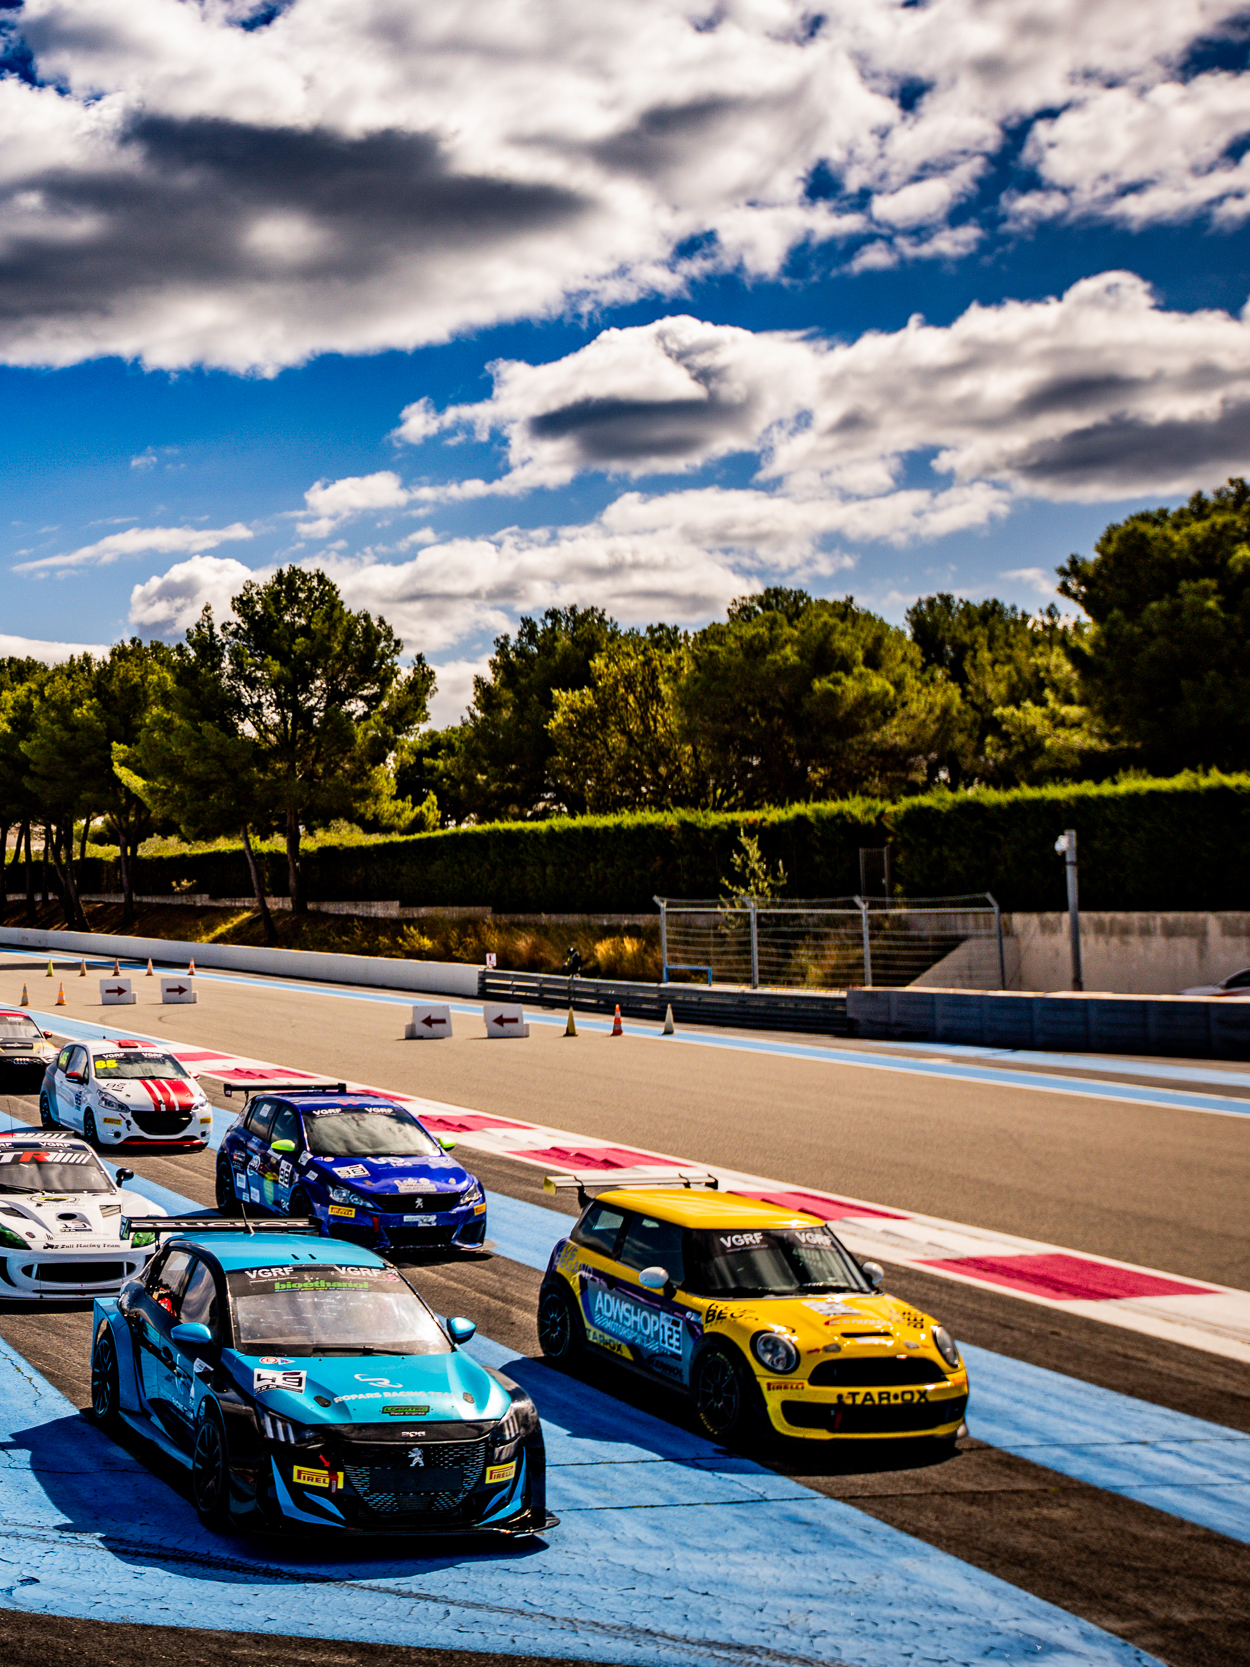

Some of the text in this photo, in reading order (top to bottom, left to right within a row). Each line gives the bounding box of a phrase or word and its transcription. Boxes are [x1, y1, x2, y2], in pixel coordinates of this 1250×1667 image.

[95, 1060, 118, 1069] 85
[720, 1232, 764, 1248] VGRF
[795, 1232, 831, 1247] VGRF
[245, 1266, 294, 1279] VGRF
[334, 1266, 384, 1277] VGRF
[595, 1290, 660, 1338] ADWSHOP
[334, 1391, 382, 1404] ROPARS
[383, 1390, 427, 1399] RACING
[297, 1469, 333, 1485] PIREL
[489, 1465, 514, 1481] PIRELLI
